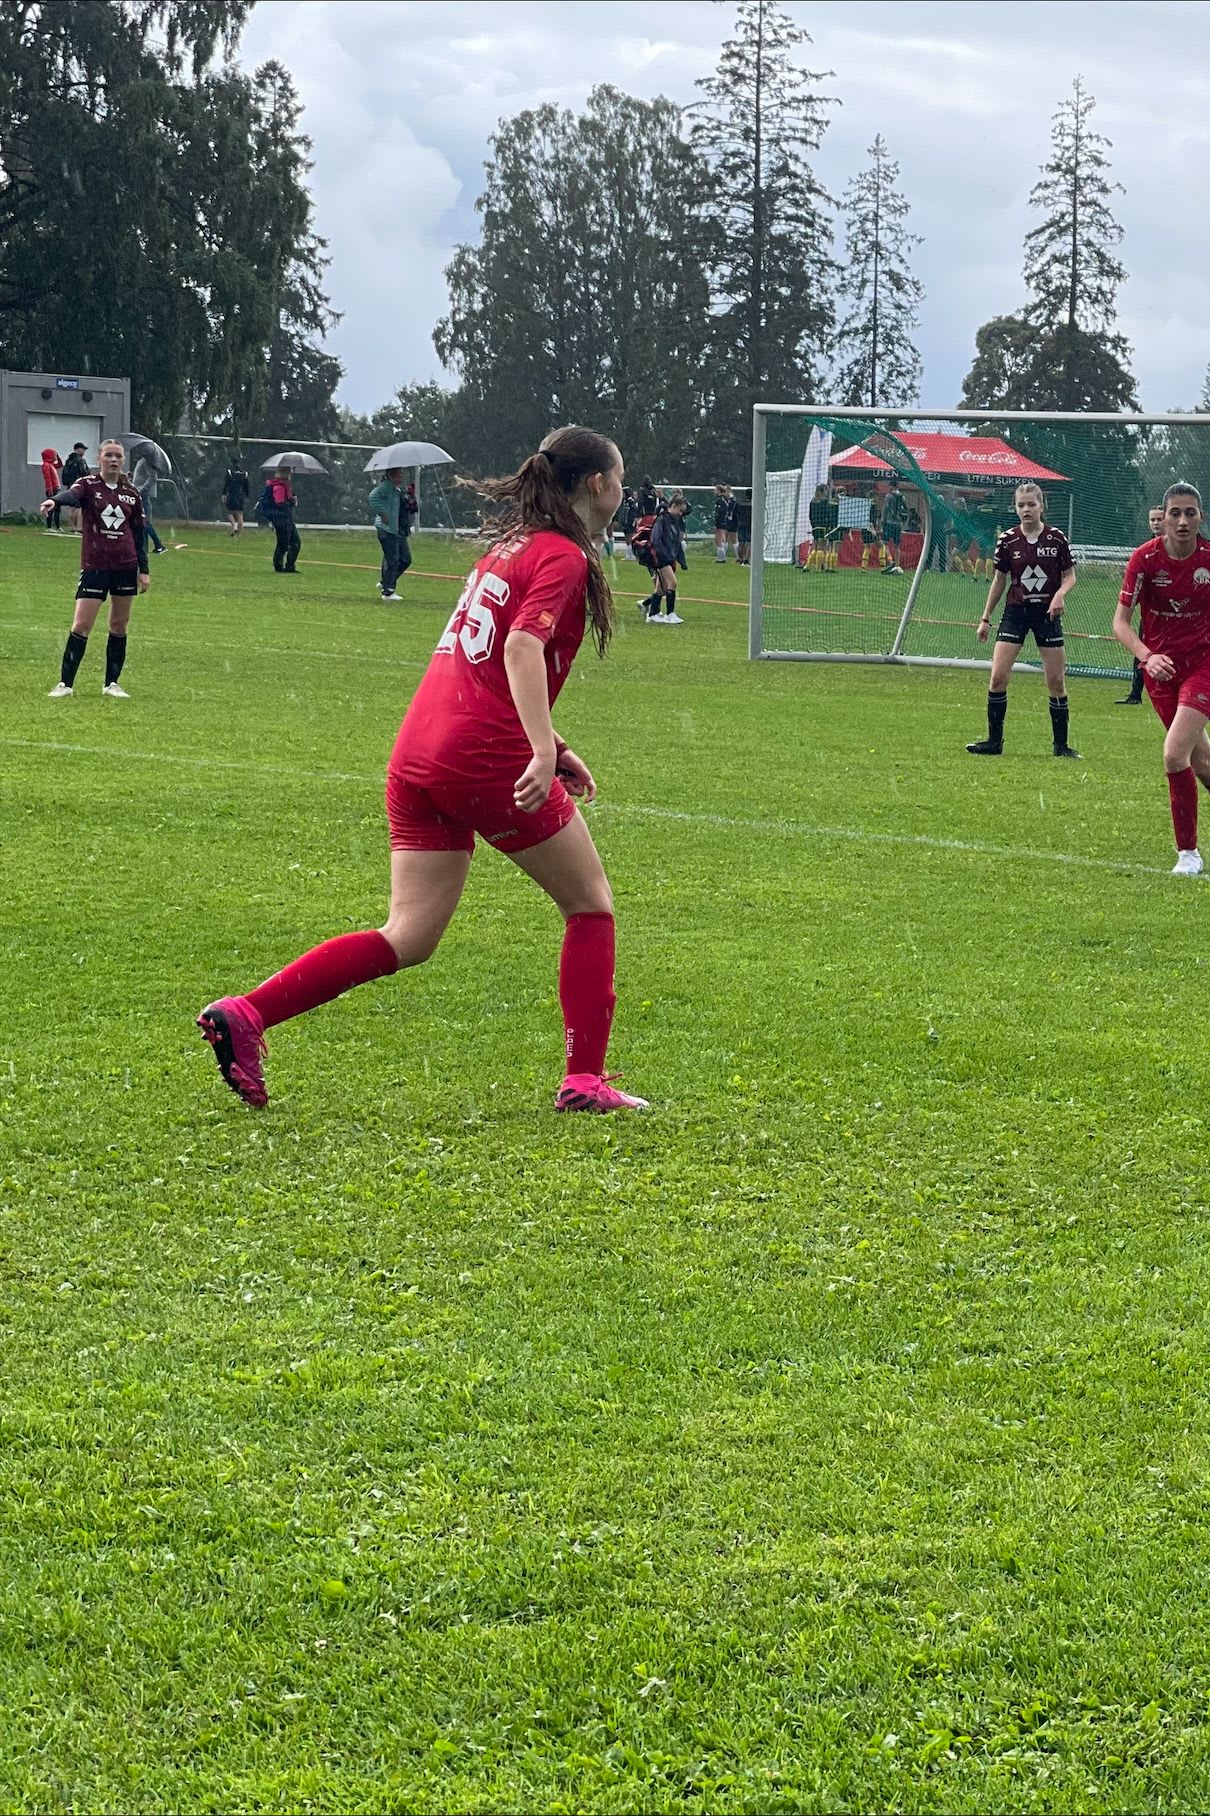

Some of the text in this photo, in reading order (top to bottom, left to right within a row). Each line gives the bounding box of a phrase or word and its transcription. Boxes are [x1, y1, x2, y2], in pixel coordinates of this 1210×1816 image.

[959, 450, 1017, 465] Coca-Cola
[873, 470, 899, 478] UTEN
[967, 474, 993, 484] UTEN
[118, 494, 136, 505] MTG
[1036, 547, 1058, 556] MTG
[434, 568, 511, 664] 25
[487, 829, 518, 842] umbro
[566, 1028, 574, 1057] umbro
